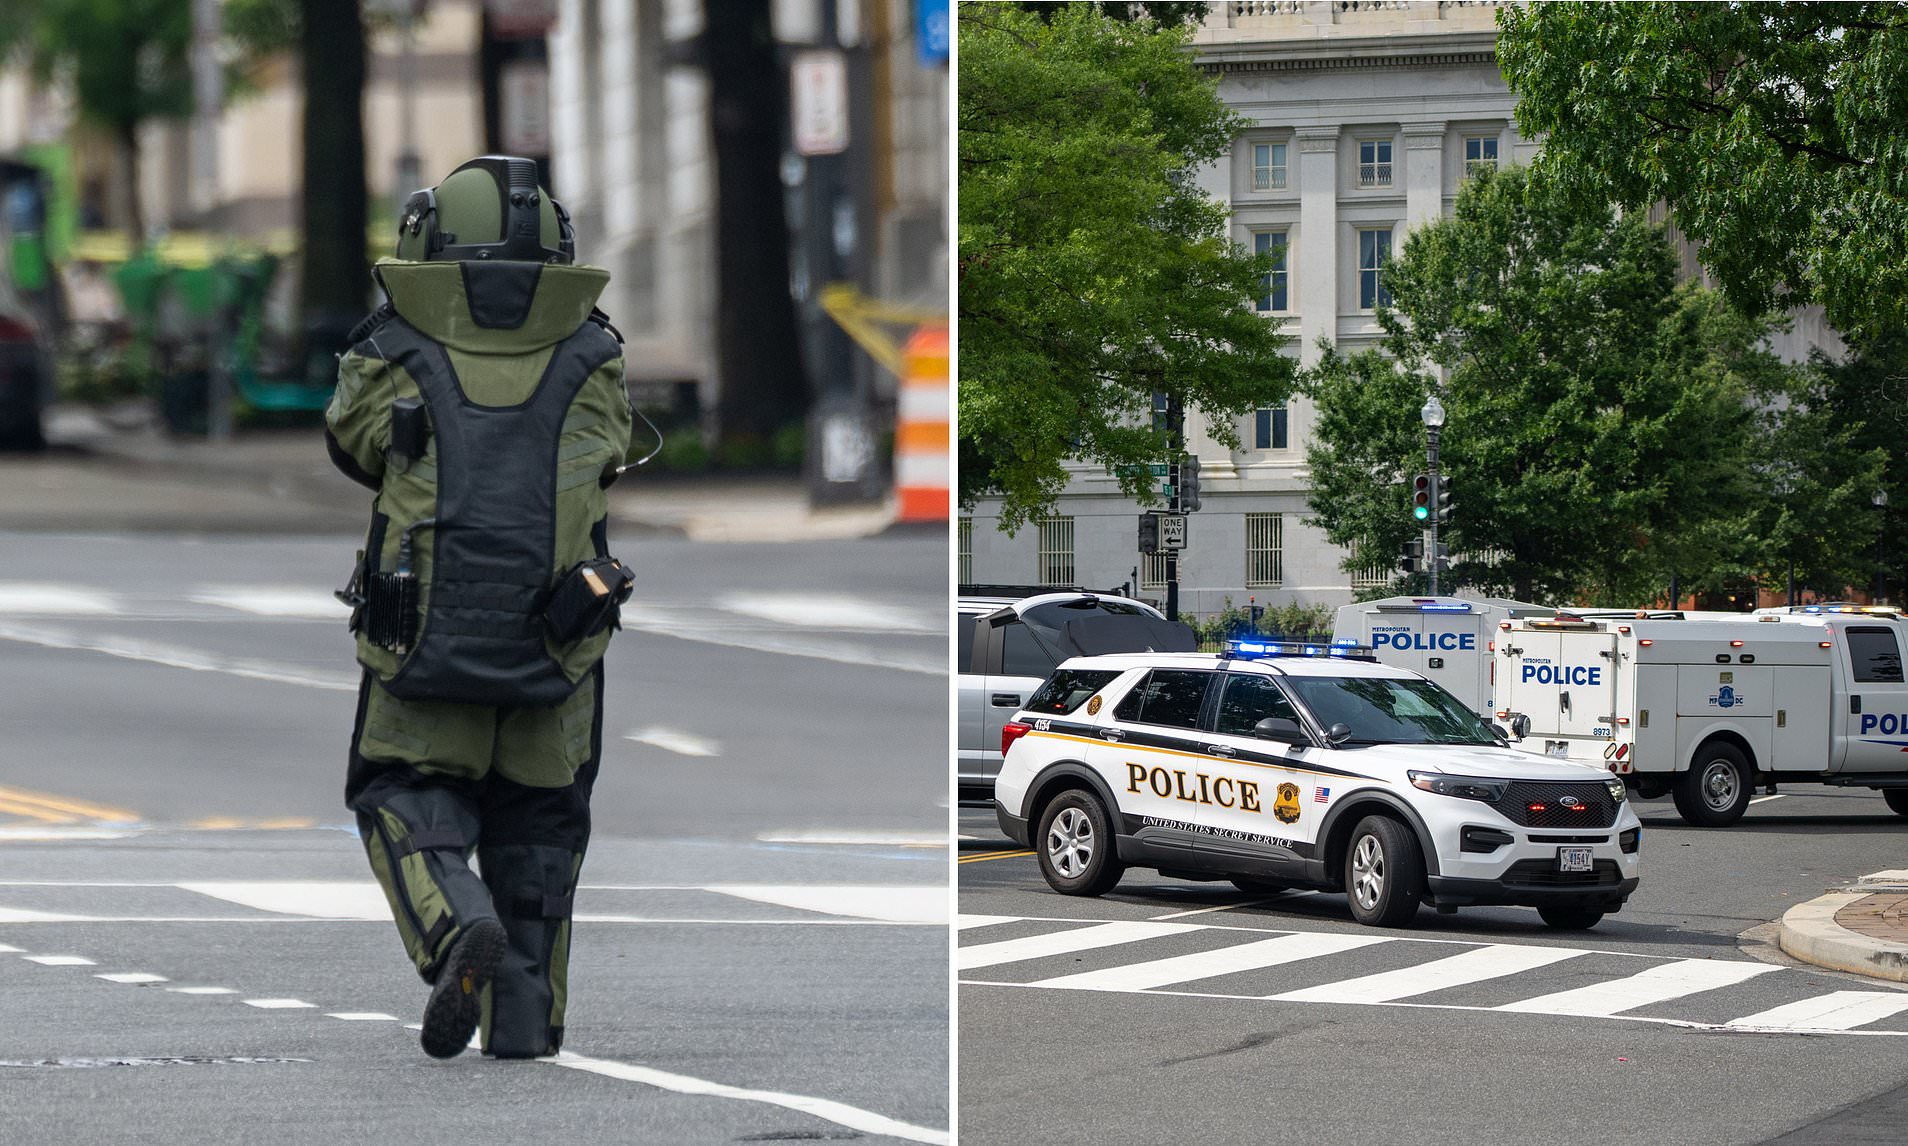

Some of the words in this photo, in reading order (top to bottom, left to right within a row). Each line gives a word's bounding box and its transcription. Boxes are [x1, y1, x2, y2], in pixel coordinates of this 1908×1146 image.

[1164, 518, 1182, 527] ONE
[1164, 527, 1182, 535] WAY
[1372, 632, 1475, 650] POLICE
[1522, 665, 1600, 685] POLICE
[1034, 719, 1052, 731] 4154
[1592, 727, 1611, 736] 8973
[1125, 761, 1262, 813] POLICE
[1142, 816, 1177, 828] UNITED
[1177, 821, 1211, 834] STATES
[1213, 827, 1251, 840] SECRET
[1252, 833, 1294, 848] SERVICE
